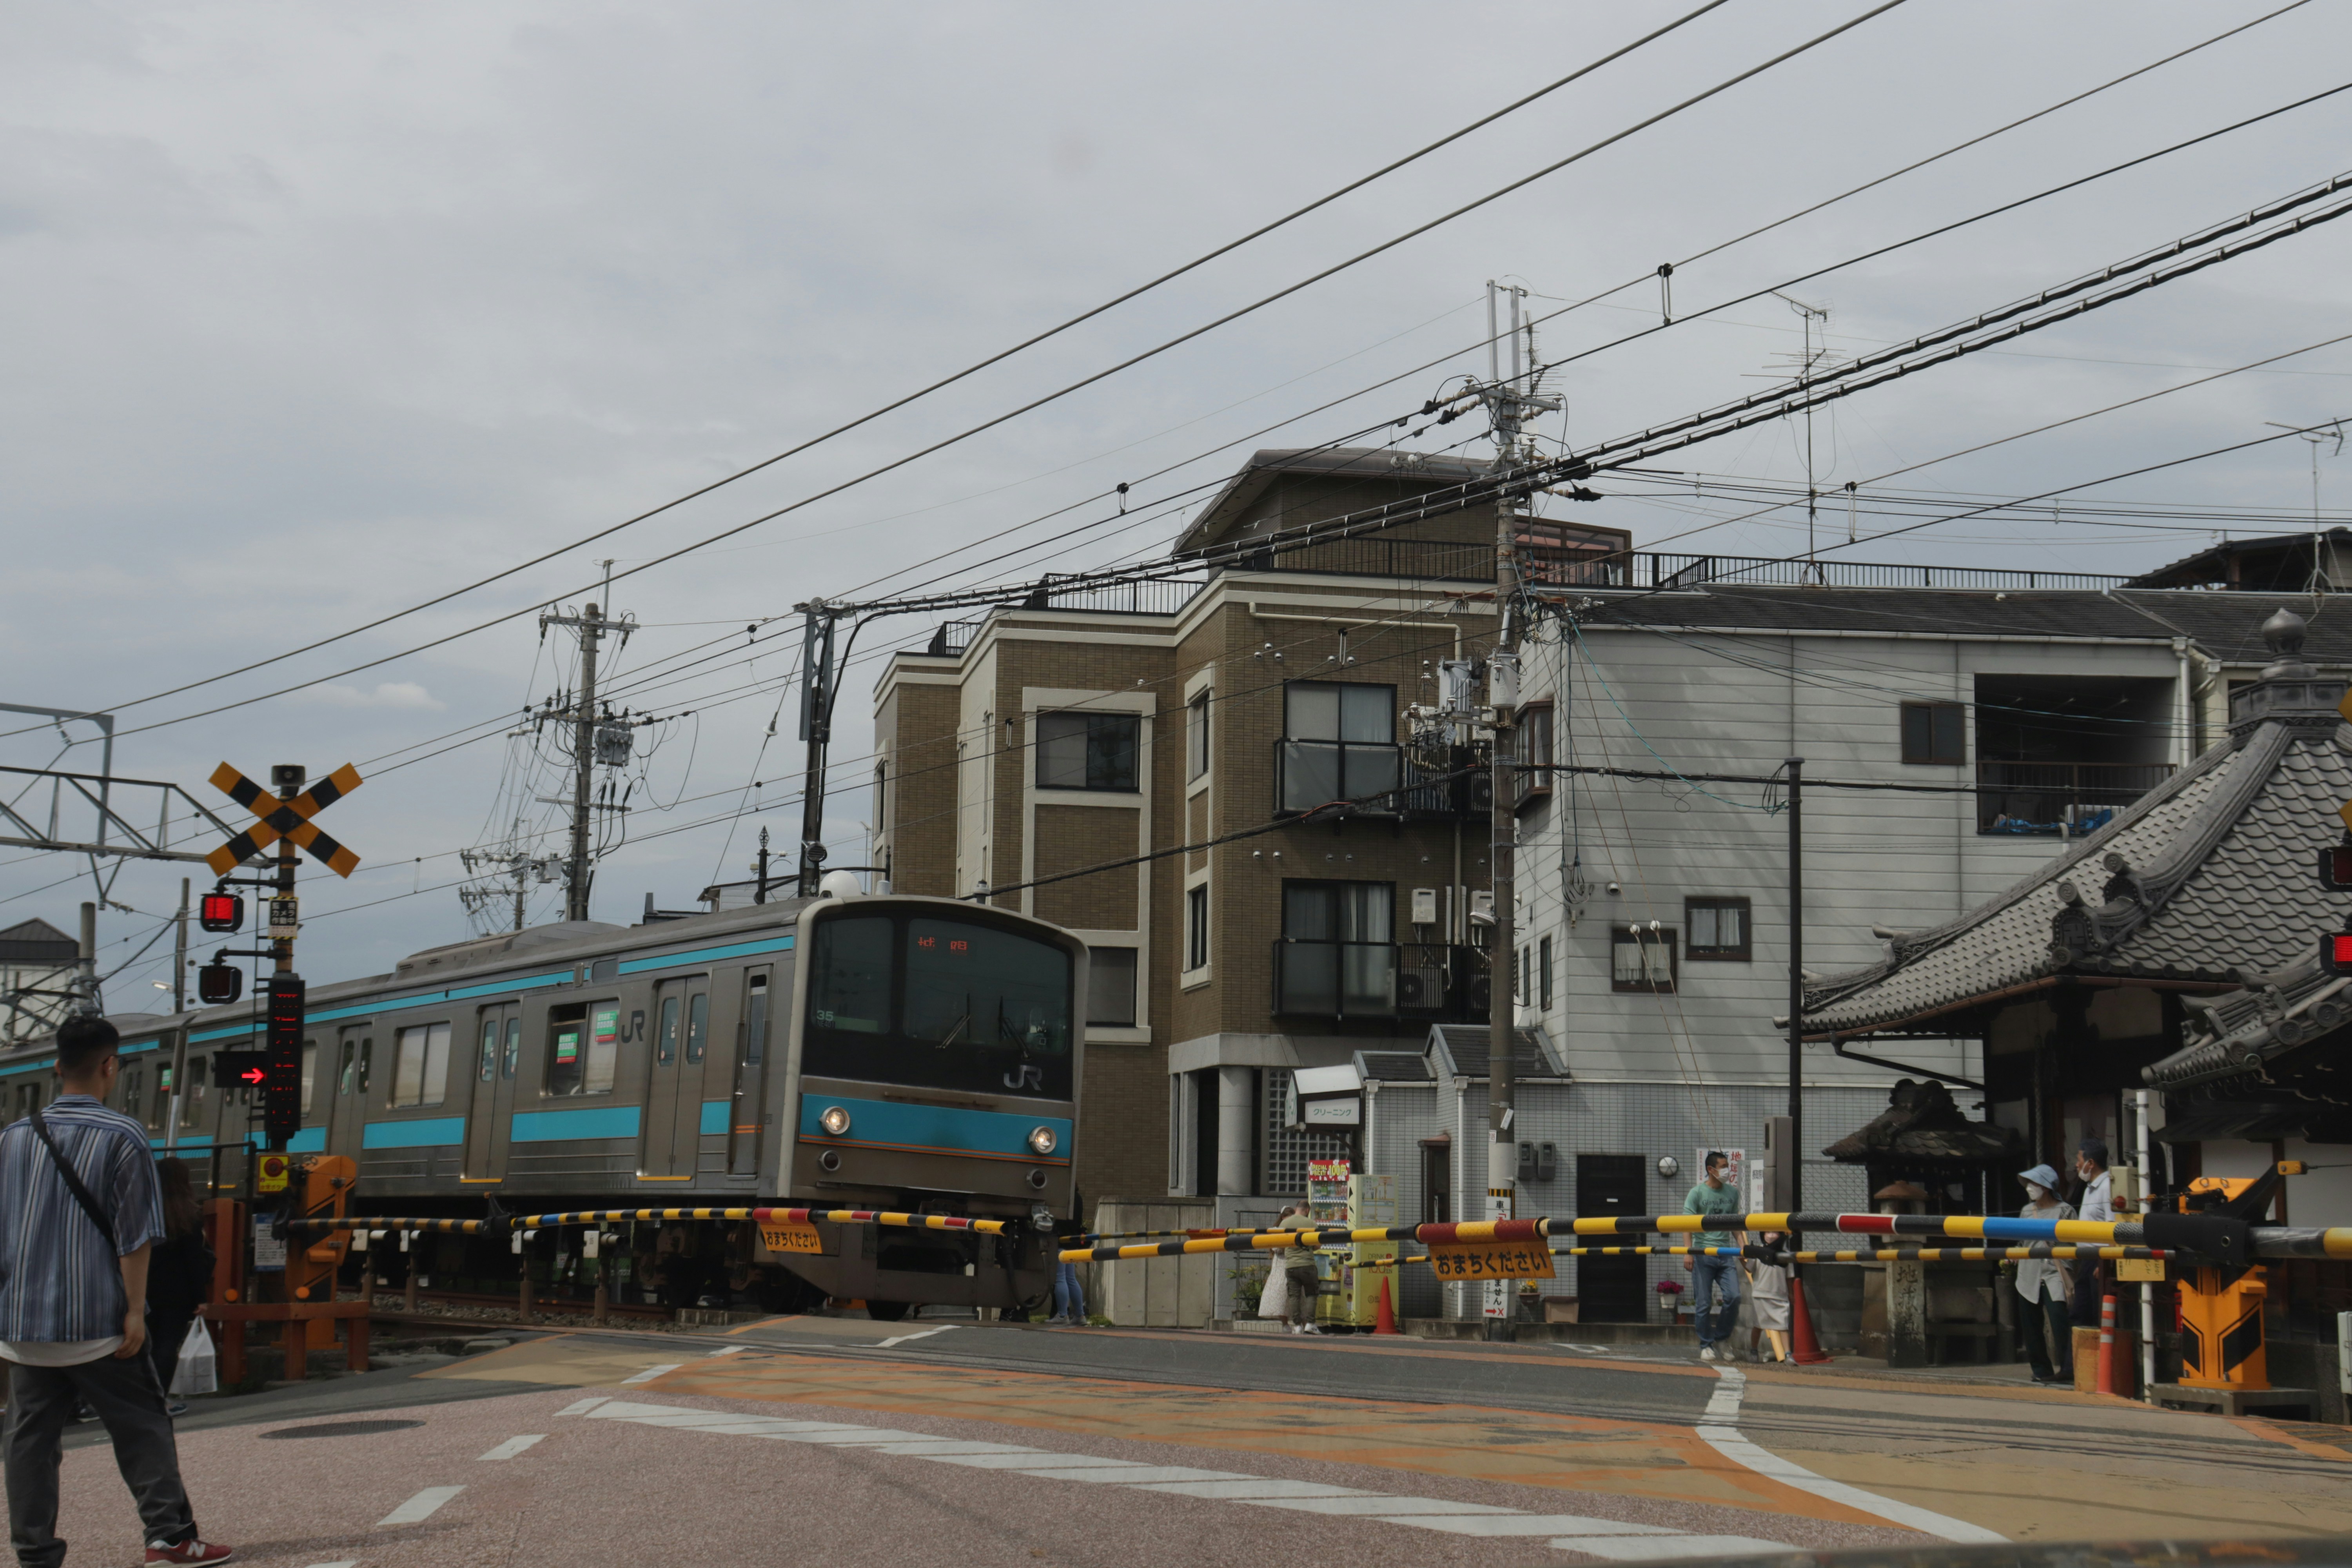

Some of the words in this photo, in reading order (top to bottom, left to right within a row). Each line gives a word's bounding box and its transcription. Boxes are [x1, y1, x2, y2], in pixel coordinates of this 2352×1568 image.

[817, 1010, 834, 1022] 35
[621, 1010, 645, 1043] JR
[1004, 1065, 1042, 1091] JR
[1328, 1164, 1347, 1176] 100円
[766, 1231, 817, 1248] おまちください
[1436, 1250, 1548, 1275] おまちください
[185, 1541, 206, 1558] N
